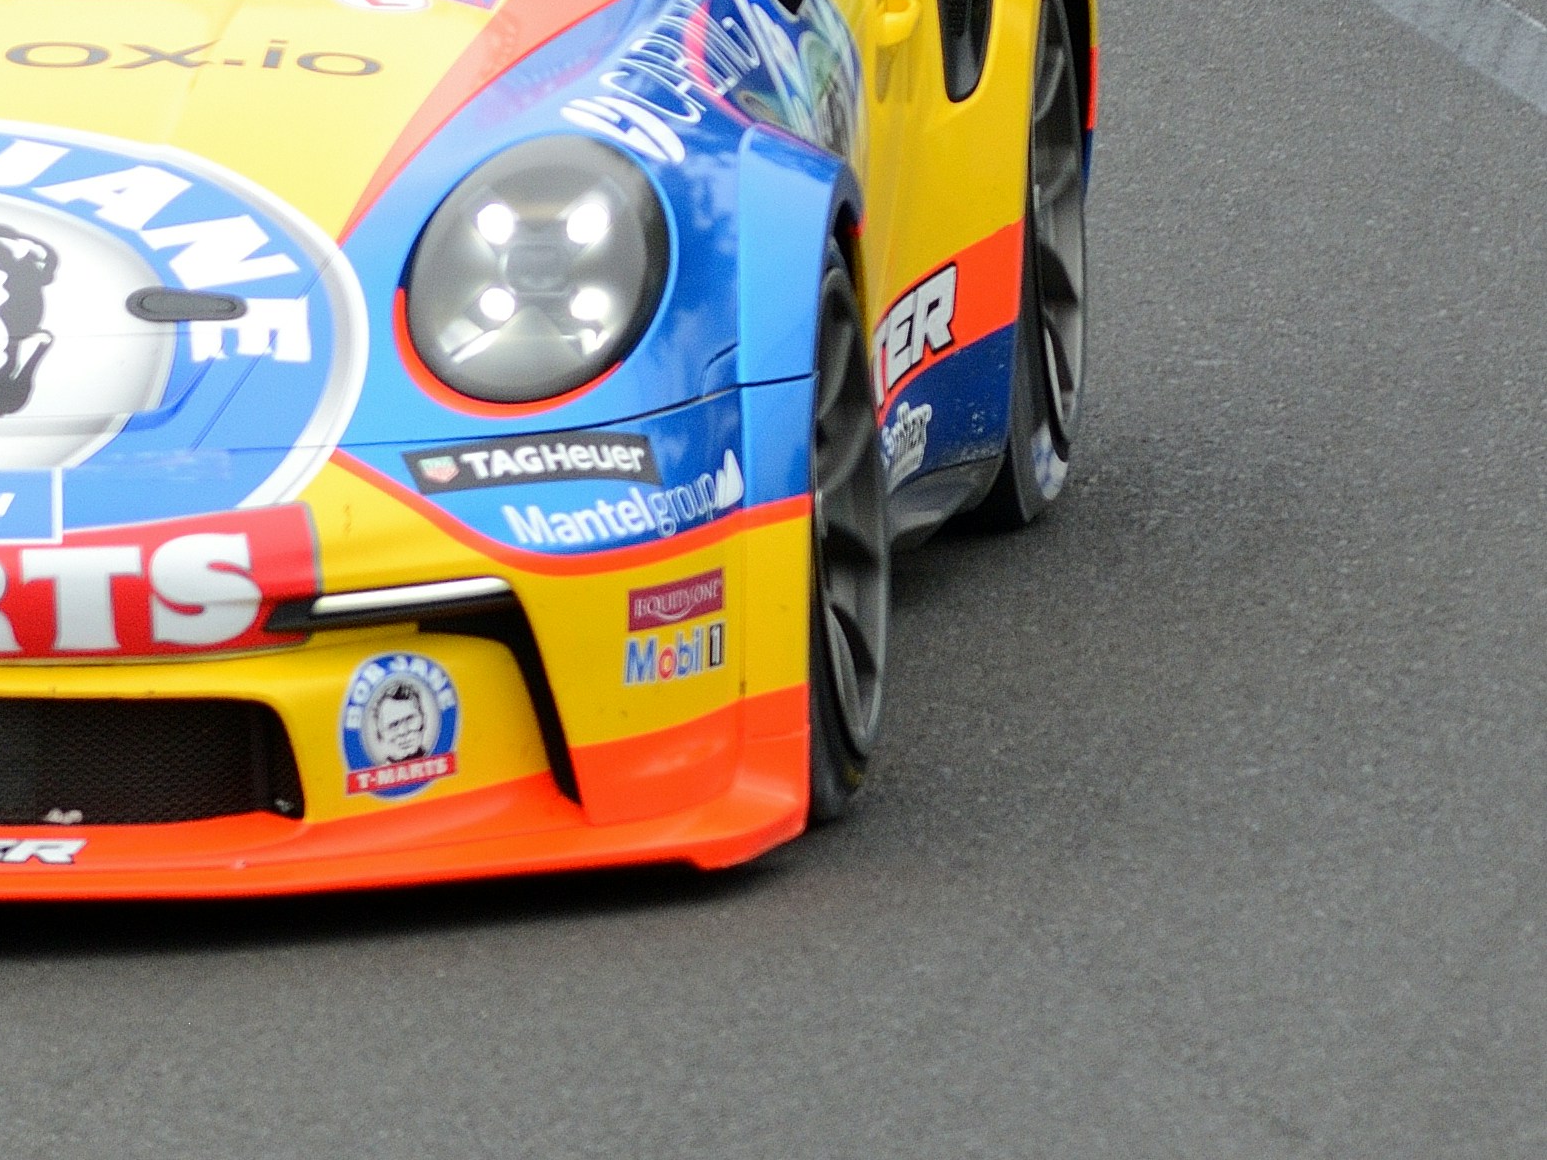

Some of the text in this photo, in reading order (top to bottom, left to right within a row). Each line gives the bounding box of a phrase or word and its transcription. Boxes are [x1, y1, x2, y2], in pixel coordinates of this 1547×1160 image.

[460, 443, 645, 479] TAGHeuer
[624, 626, 702, 685] Mobil
[356, 758, 449, 790] T-MARTS
